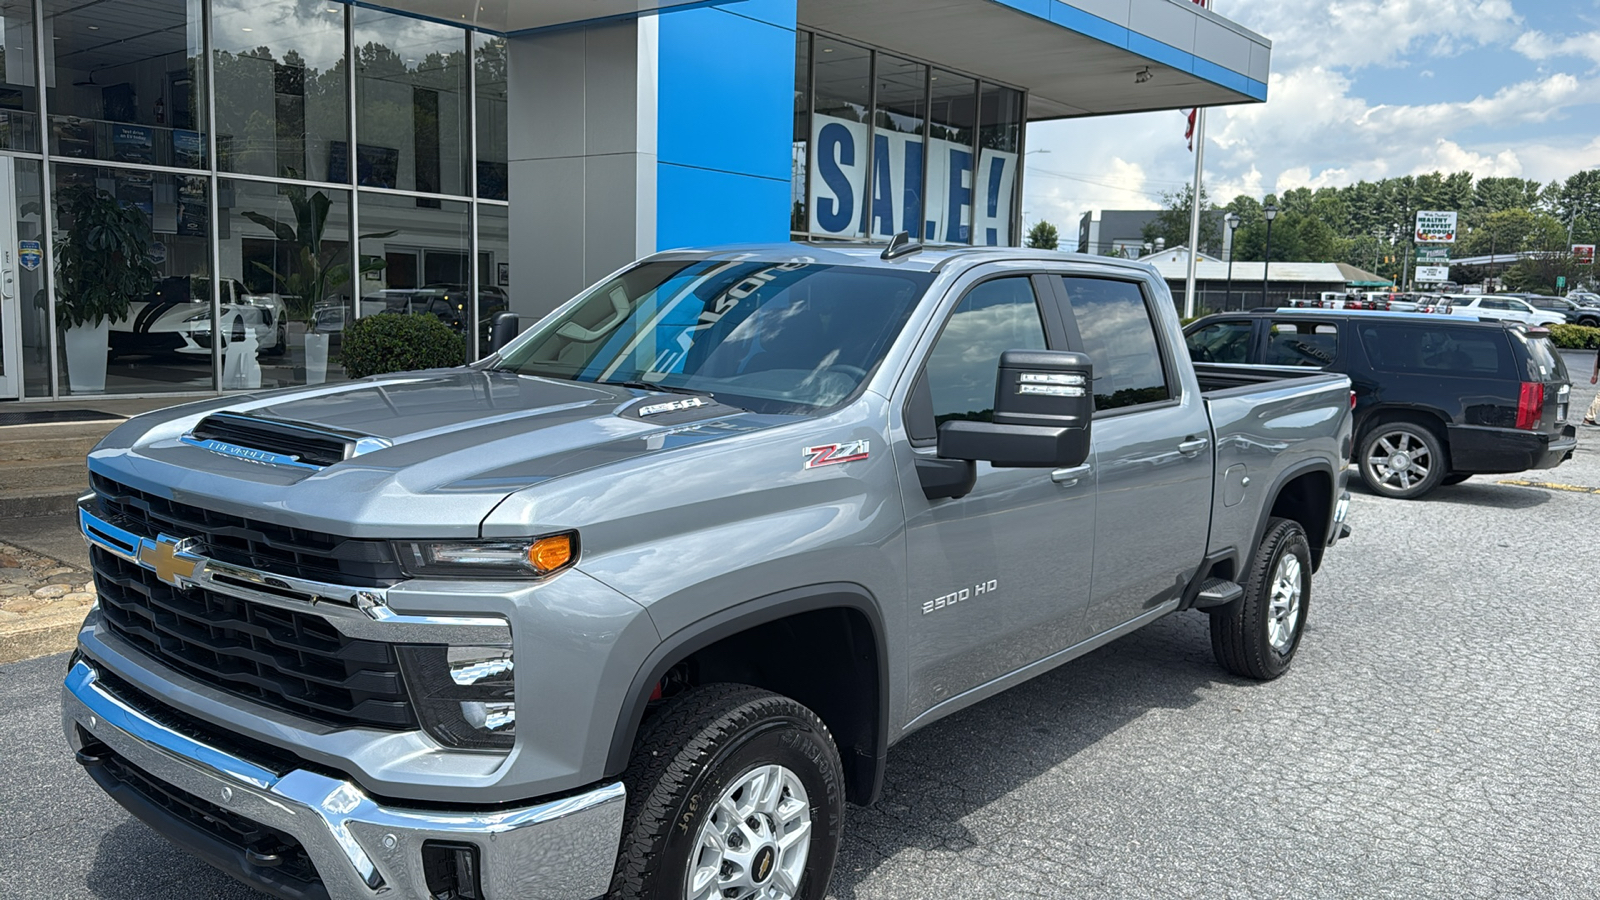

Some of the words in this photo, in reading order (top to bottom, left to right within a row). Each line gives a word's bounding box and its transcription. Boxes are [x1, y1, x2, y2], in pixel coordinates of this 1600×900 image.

[817, 122, 1006, 246] SALE!
[802, 440, 870, 469] Z71
[922, 588, 970, 615] 2500
[974, 579, 998, 597] HD
[777, 728, 837, 805] ANSFORCE
